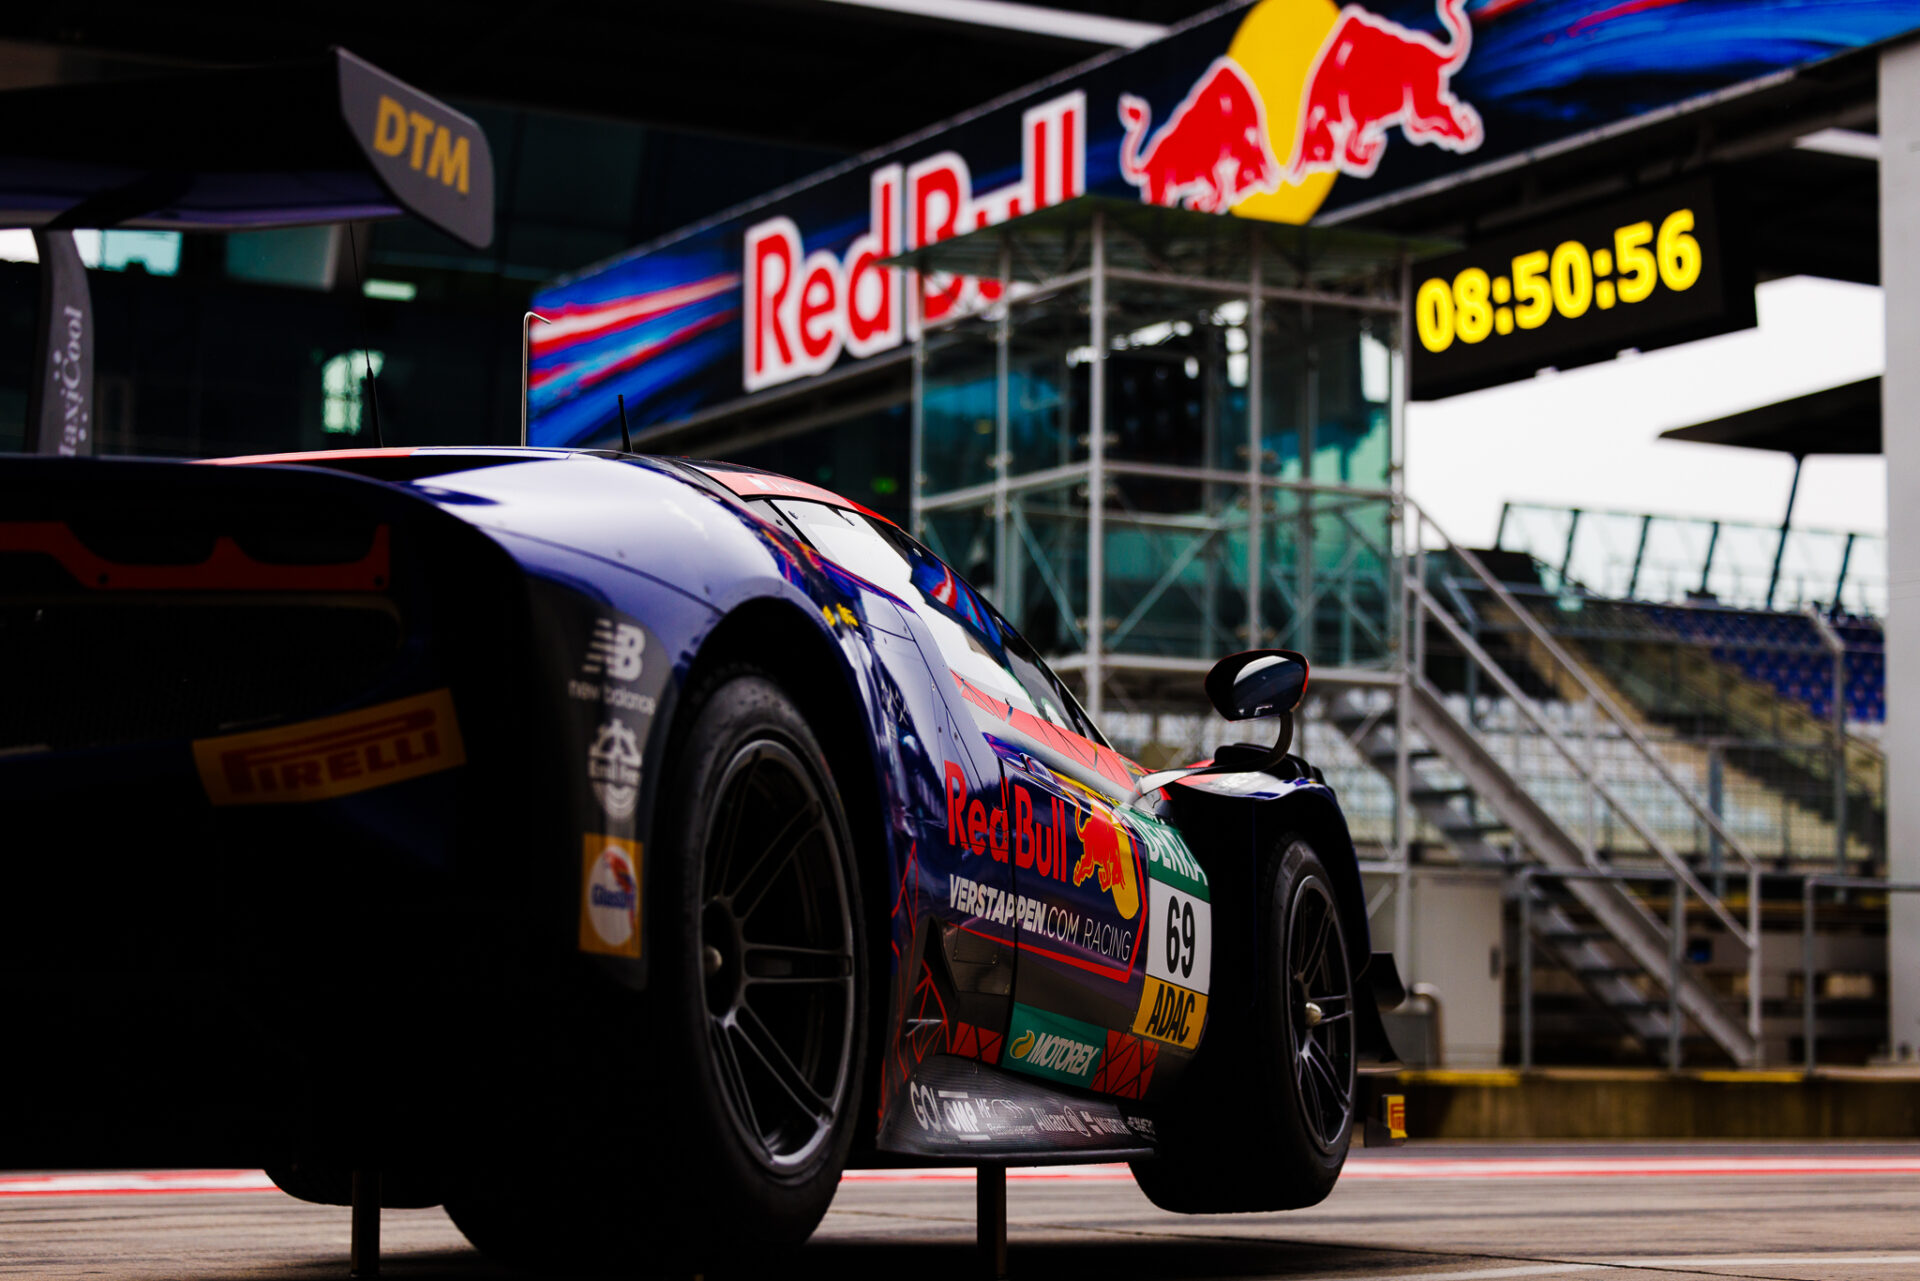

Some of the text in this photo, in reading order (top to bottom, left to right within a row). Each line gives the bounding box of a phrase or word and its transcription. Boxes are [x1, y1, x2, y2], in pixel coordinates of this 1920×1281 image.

[374, 96, 470, 194] DTM
[749, 172, 895, 383] Red
[1415, 208, 1702, 354] 08:50:56
[221, 709, 440, 795] PIRELLI
[945, 760, 1068, 883] Red Bull
[949, 873, 1132, 962] VERSTAPPEN.COM RACING
[1166, 895, 1195, 979] 69
[1026, 1032, 1100, 1077] MOTOREX
[1145, 983, 1195, 1044] ADAC
[943, 1100, 980, 1133] OMP
[1030, 1107, 1075, 1132] Allianz
